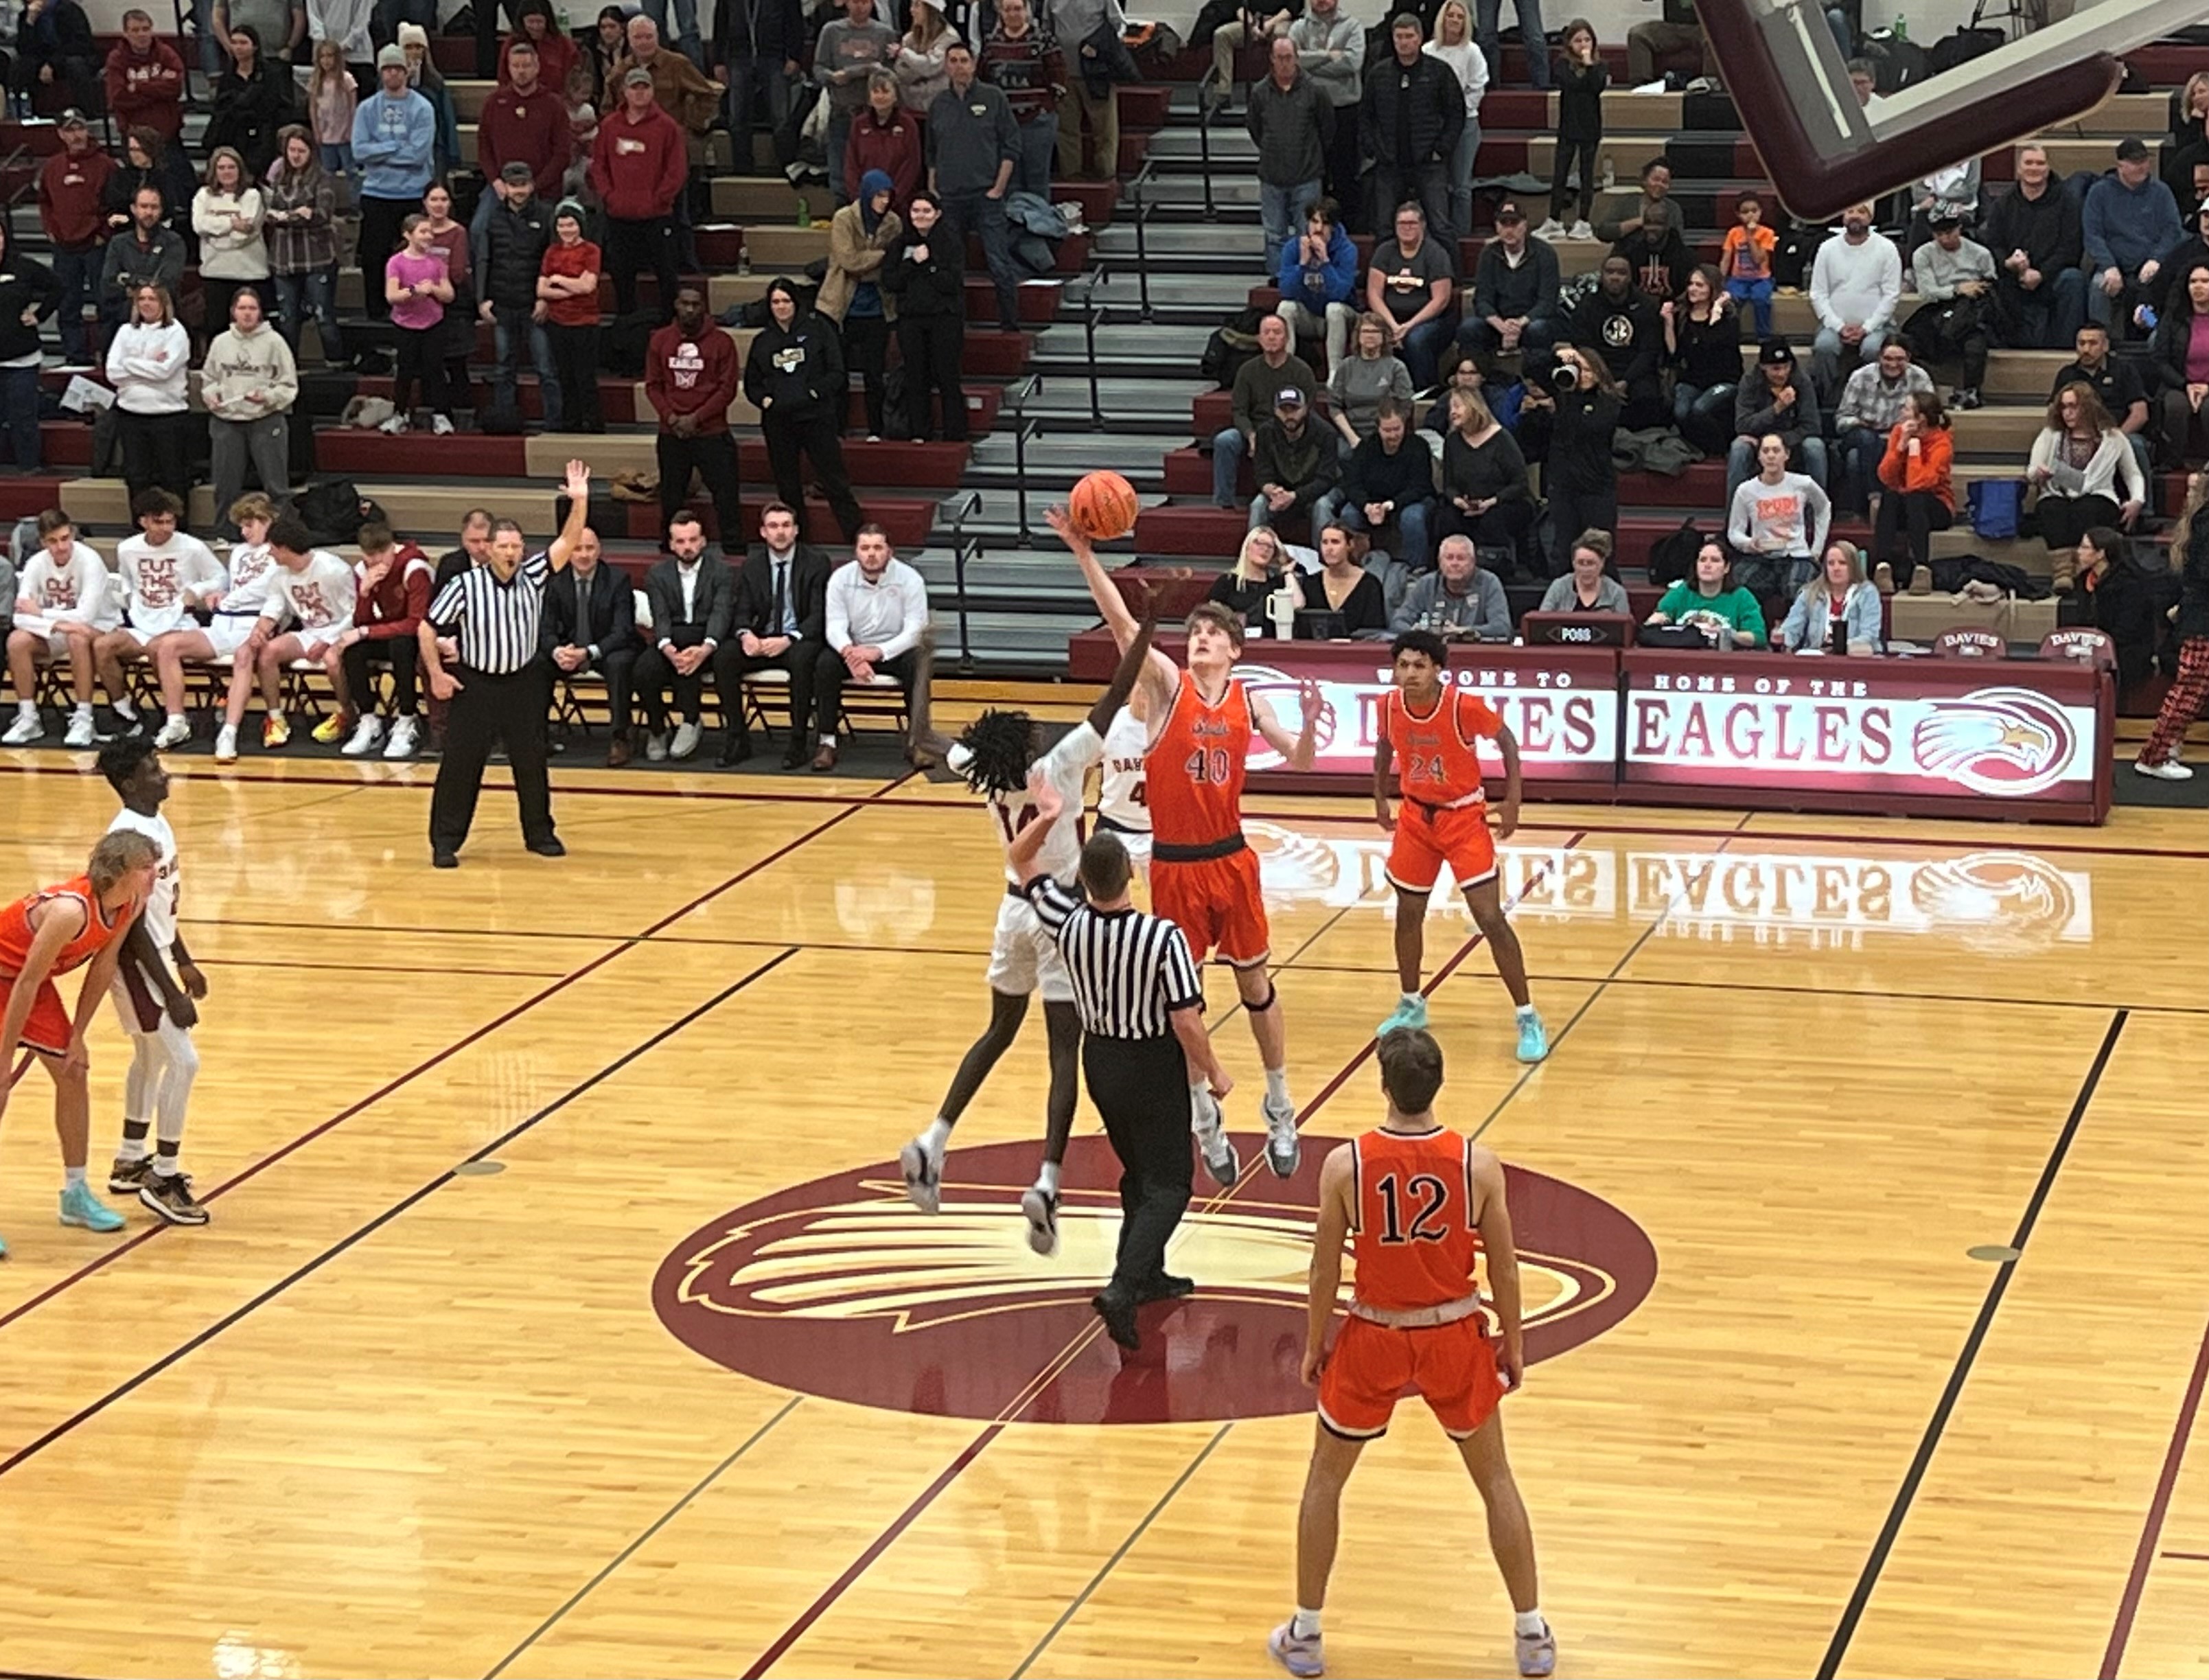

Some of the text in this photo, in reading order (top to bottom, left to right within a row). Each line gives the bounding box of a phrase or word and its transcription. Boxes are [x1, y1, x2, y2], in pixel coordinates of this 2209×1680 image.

[139, 557, 176, 573] CUT
[1943, 632, 1999, 647] DAVIES
[1377, 669, 1572, 687] WCOME TO
[1654, 674, 1867, 698] HOME OF THE
[1354, 691, 1597, 755] DIES
[1632, 698, 1893, 766] EAGLES
[1185, 746, 1230, 786] 40
[1409, 755, 1448, 785] 24
[1376, 1173, 1449, 1245] 12
